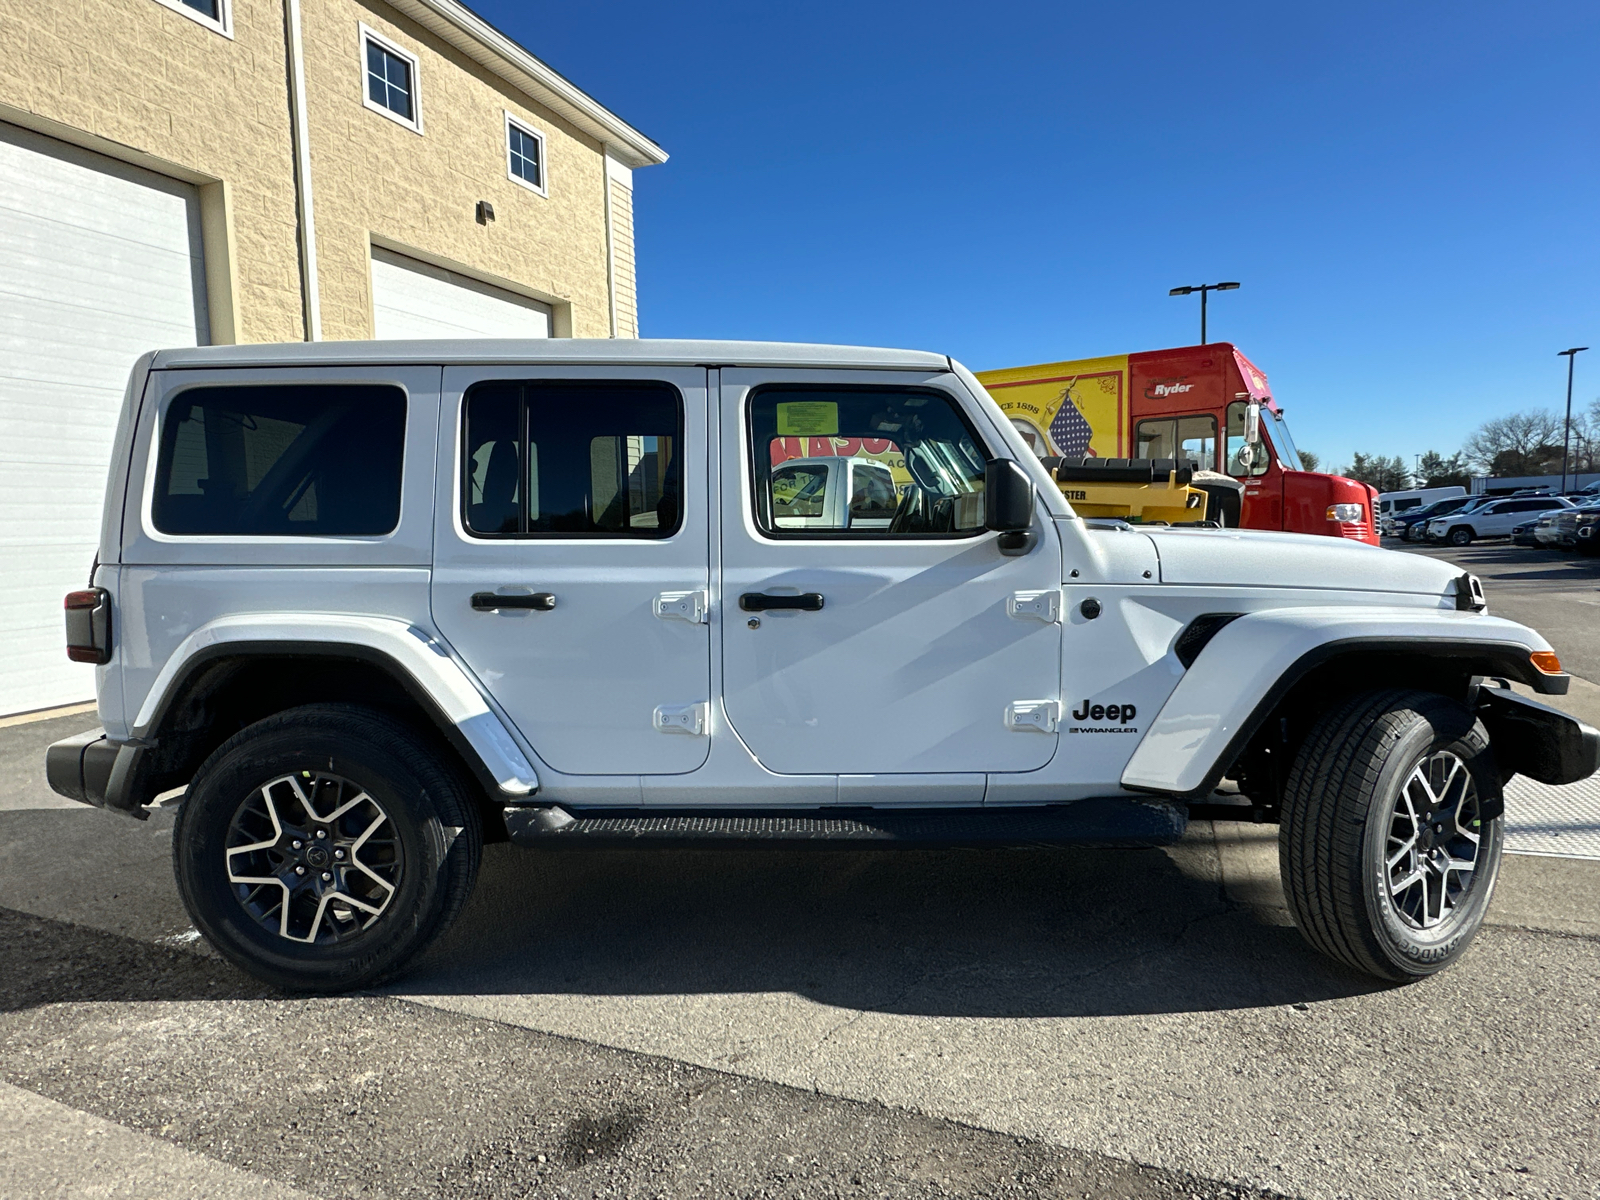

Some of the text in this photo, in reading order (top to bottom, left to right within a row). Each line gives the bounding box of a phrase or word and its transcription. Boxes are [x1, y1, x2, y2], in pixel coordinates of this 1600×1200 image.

[1154, 383, 1193, 397] Ryder
[999, 402, 1040, 414] CE 1898
[773, 480, 796, 494] FOR
[1061, 490, 1086, 500] STER
[1072, 699, 1136, 724] Jeep
